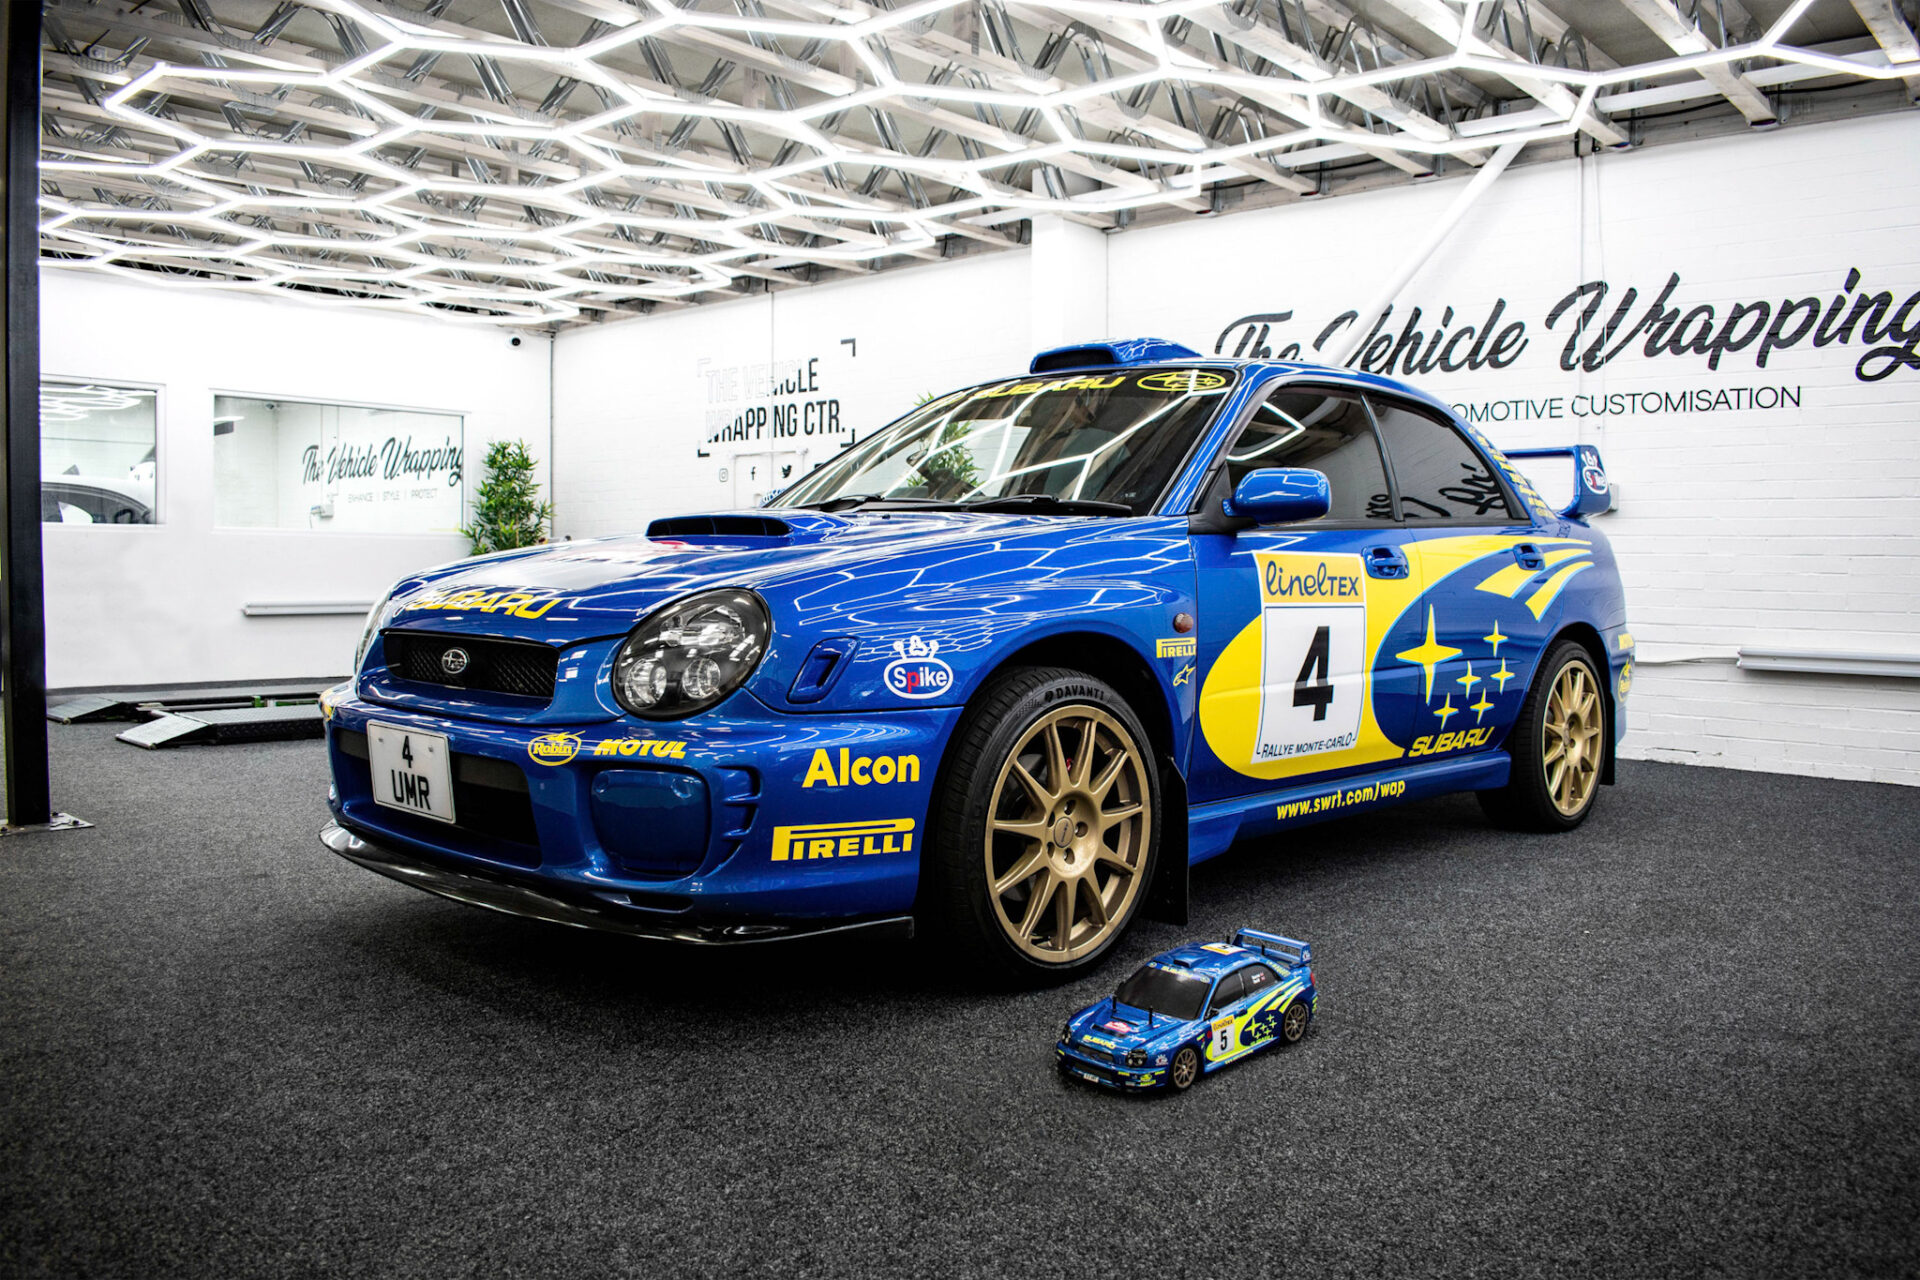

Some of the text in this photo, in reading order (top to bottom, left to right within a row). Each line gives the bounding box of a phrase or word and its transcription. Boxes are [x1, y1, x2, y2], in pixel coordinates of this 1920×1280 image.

[1545, 267, 1920, 382] Wrapping
[803, 398, 846, 436] CTR.
[1448, 385, 1801, 423] OMOTIVE CUSTOMISATION
[379, 435, 463, 487] Wrapping
[1156, 637, 1197, 659] PIRELLI
[893, 666, 948, 693] Spike
[1055, 684, 1105, 701] DAVANTI
[1292, 625, 1334, 722] 4
[402, 735, 414, 769] 4
[533, 738, 688, 760] Robin MOTUL
[1261, 732, 1353, 759] RALLYE MONTE-CARLO
[1408, 725, 1496, 758] SUBARU
[801, 747, 920, 788] Alcon
[391, 769, 431, 811] UMR
[1276, 779, 1406, 820] www.swrt.com/wap
[770, 817, 916, 862] PIRELLI
[1220, 1029, 1228, 1052] 5
